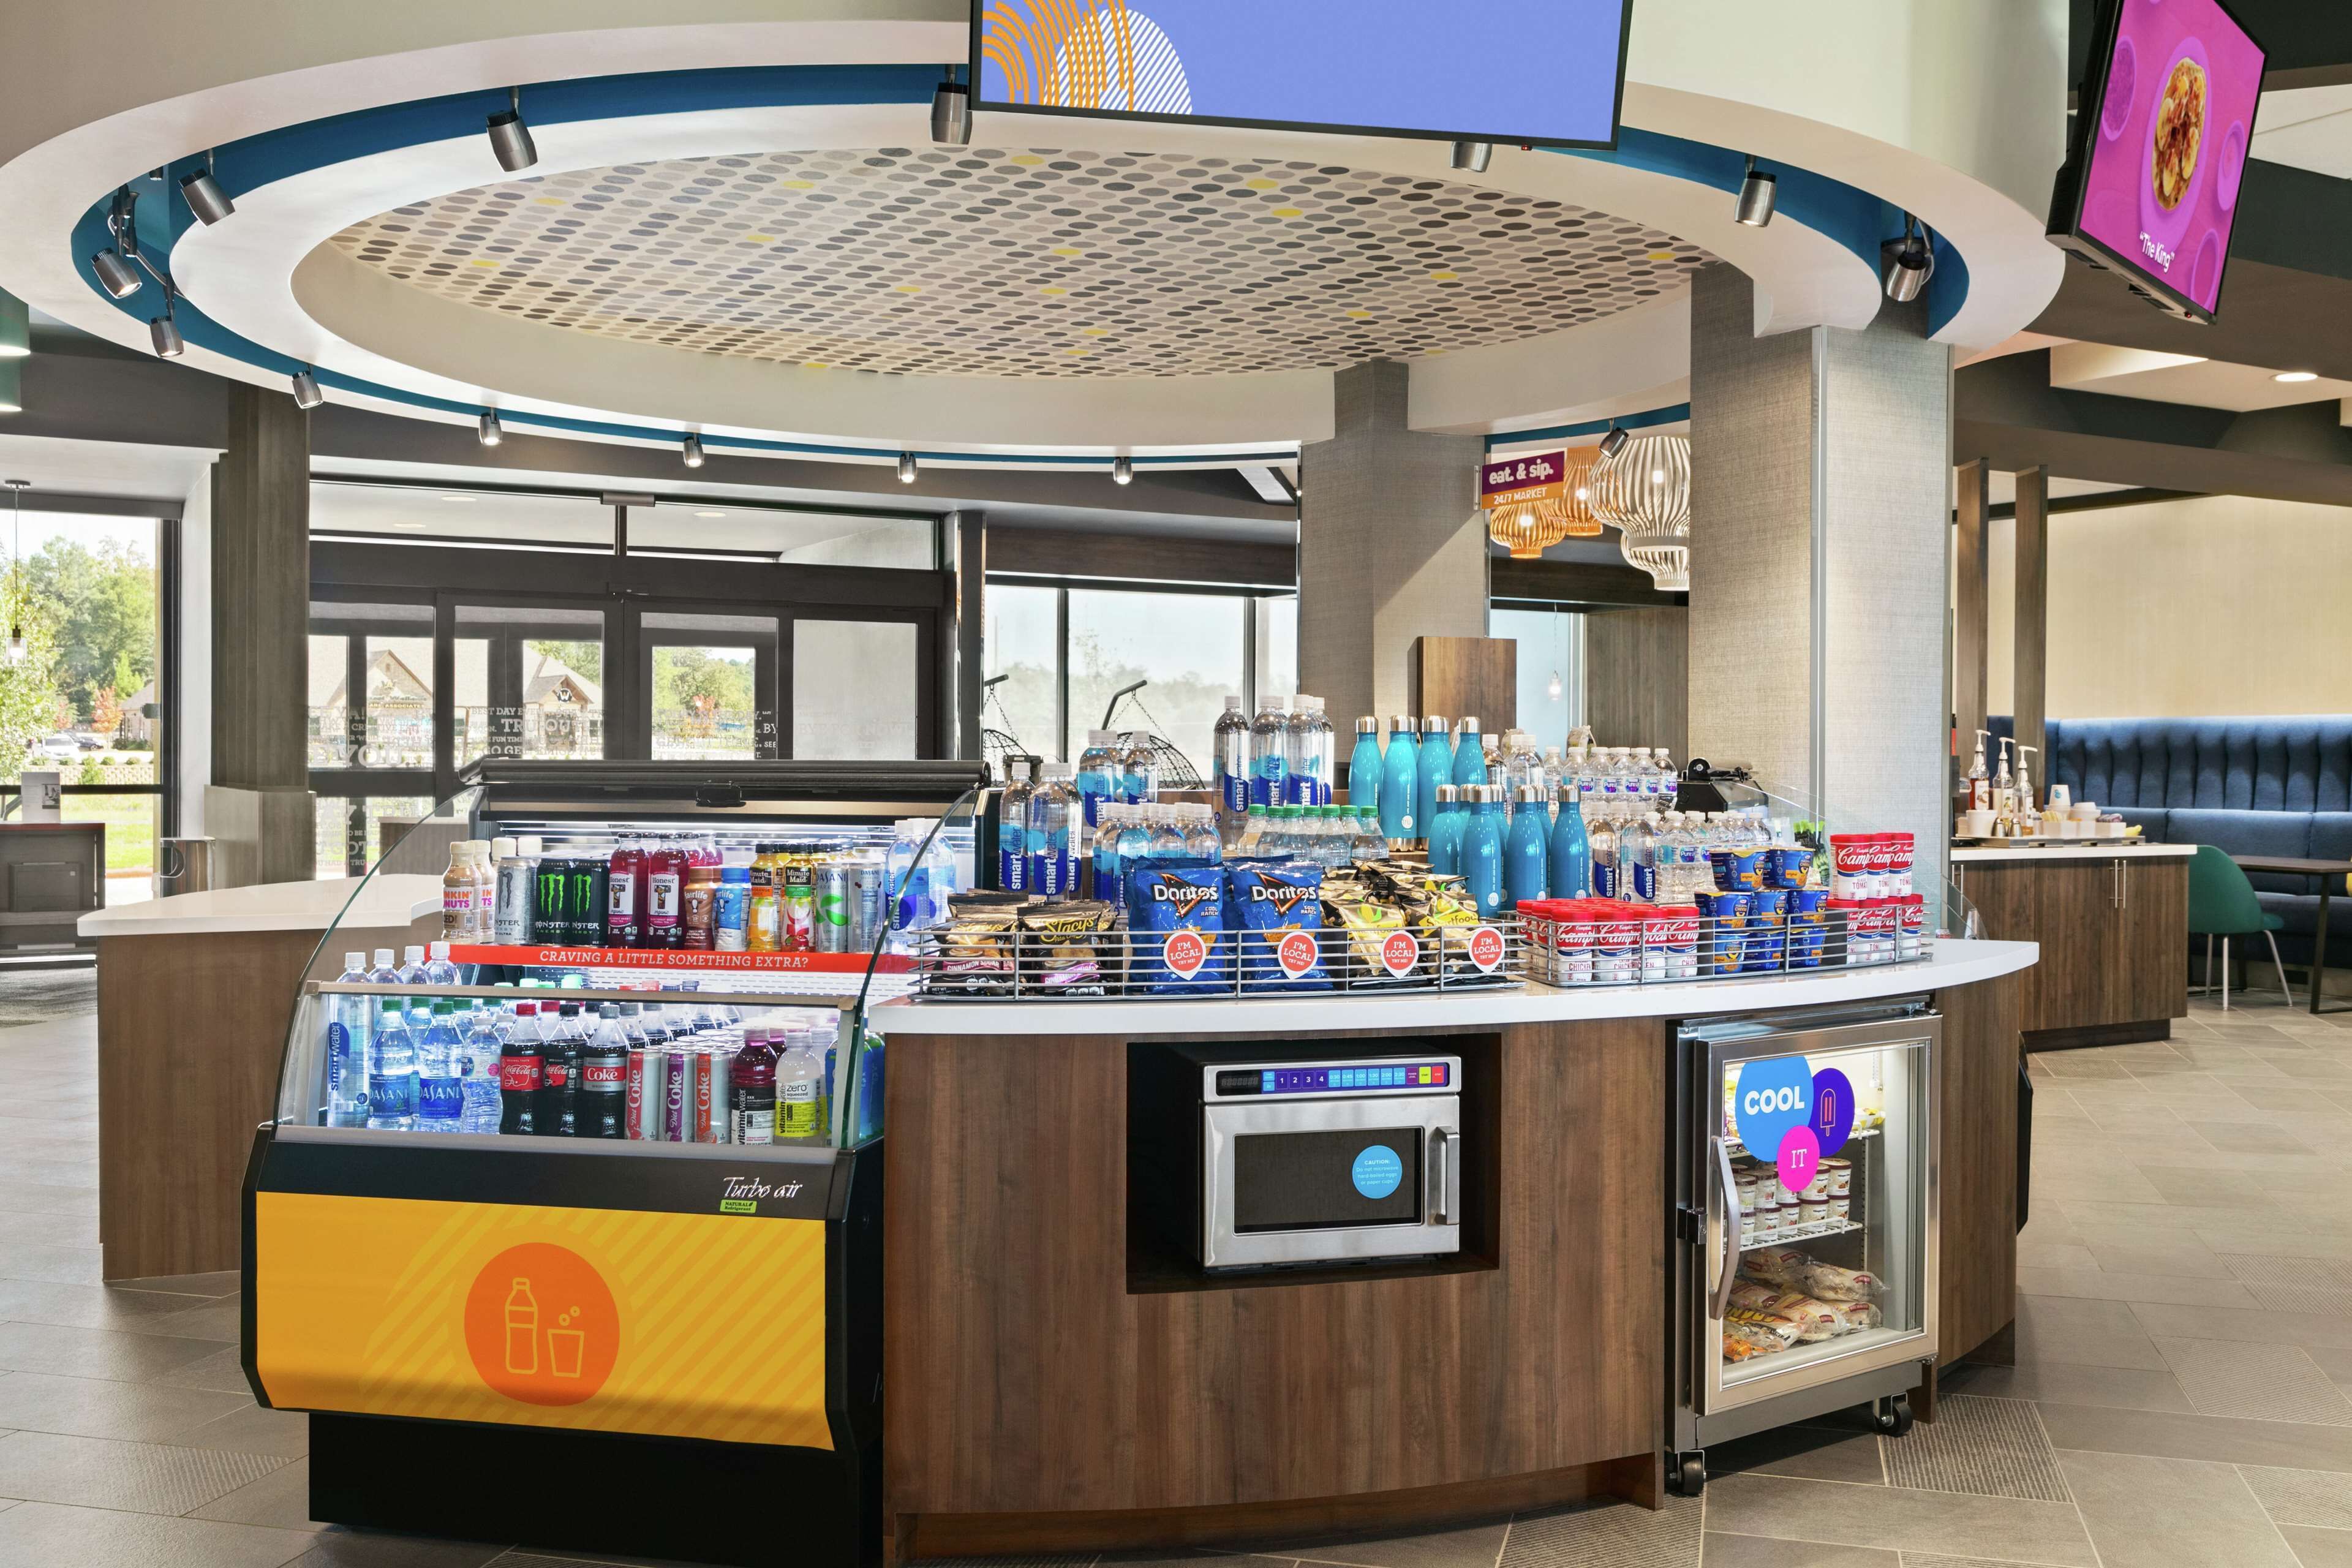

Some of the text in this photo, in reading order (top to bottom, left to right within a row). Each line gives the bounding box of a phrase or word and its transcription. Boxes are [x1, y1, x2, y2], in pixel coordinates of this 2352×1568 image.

[1489, 459, 1554, 484] eat. & sip.
[1493, 488, 1547, 505] 24/7 MARKET
[443, 891, 472, 899] NKIN'
[1154, 884, 1219, 901] Doritos
[1252, 886, 1317, 901] Doritos
[443, 899, 470, 908] NUTS
[1177, 941, 1191, 951] I'M
[1294, 941, 1307, 951] I'M
[540, 951, 809, 968] CRAVING A LITTLE SOMETHING EXTRA?
[1170, 950, 1201, 960] LOCAL
[1284, 948, 1312, 961] LOCAL
[948, 961, 979, 971] CINNAMON
[331, 1023, 339, 1091] smartwater
[505, 1065, 532, 1074] Coca-Cola
[545, 1065, 568, 1074] Coca-Cola
[587, 1068, 617, 1081] Coke
[628, 1070, 641, 1107] Coke
[668, 1071, 682, 1110] Coke
[698, 1072, 710, 1110] Coke
[786, 1084, 808, 1092] zero
[1744, 1086, 1804, 1115] COOL
[737, 1088, 746, 1145] vitaminwater
[1791, 1149, 1807, 1169] IT
[723, 1177, 804, 1199] Turbo air
